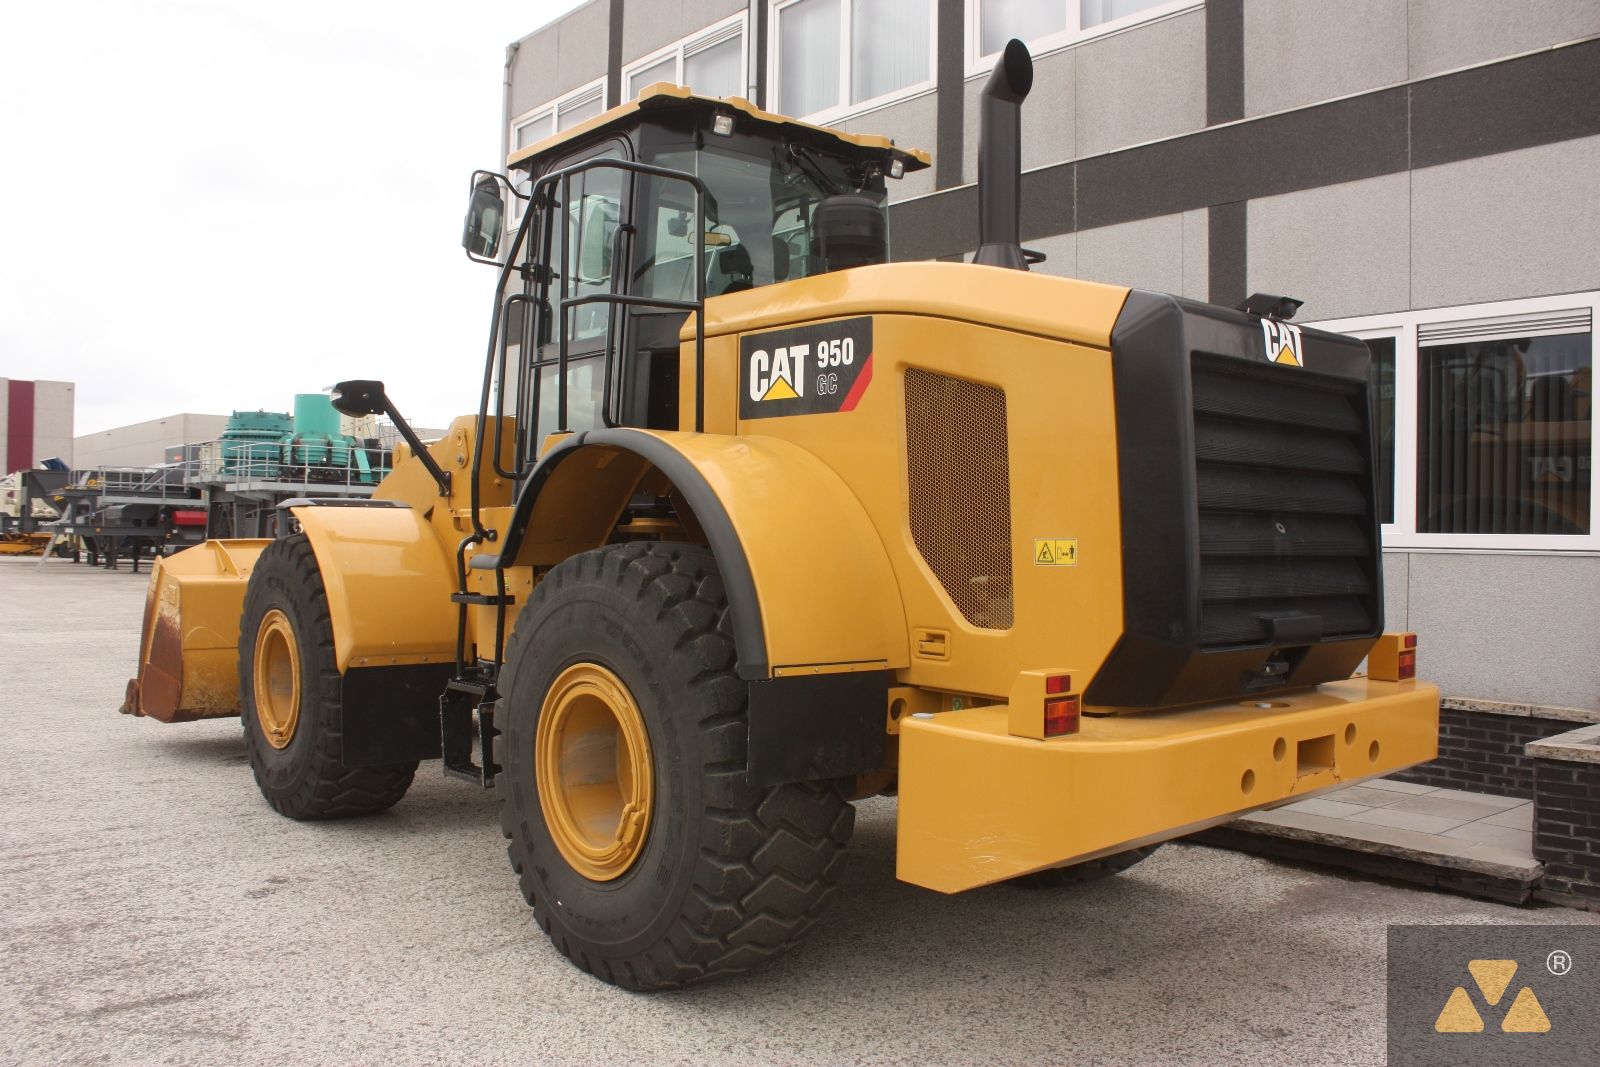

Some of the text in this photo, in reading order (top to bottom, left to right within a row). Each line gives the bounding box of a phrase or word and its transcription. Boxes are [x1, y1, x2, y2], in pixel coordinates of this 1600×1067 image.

[1260, 318, 1304, 367] CAT
[750, 337, 854, 402] CAT 950
[816, 373, 838, 395] GC
